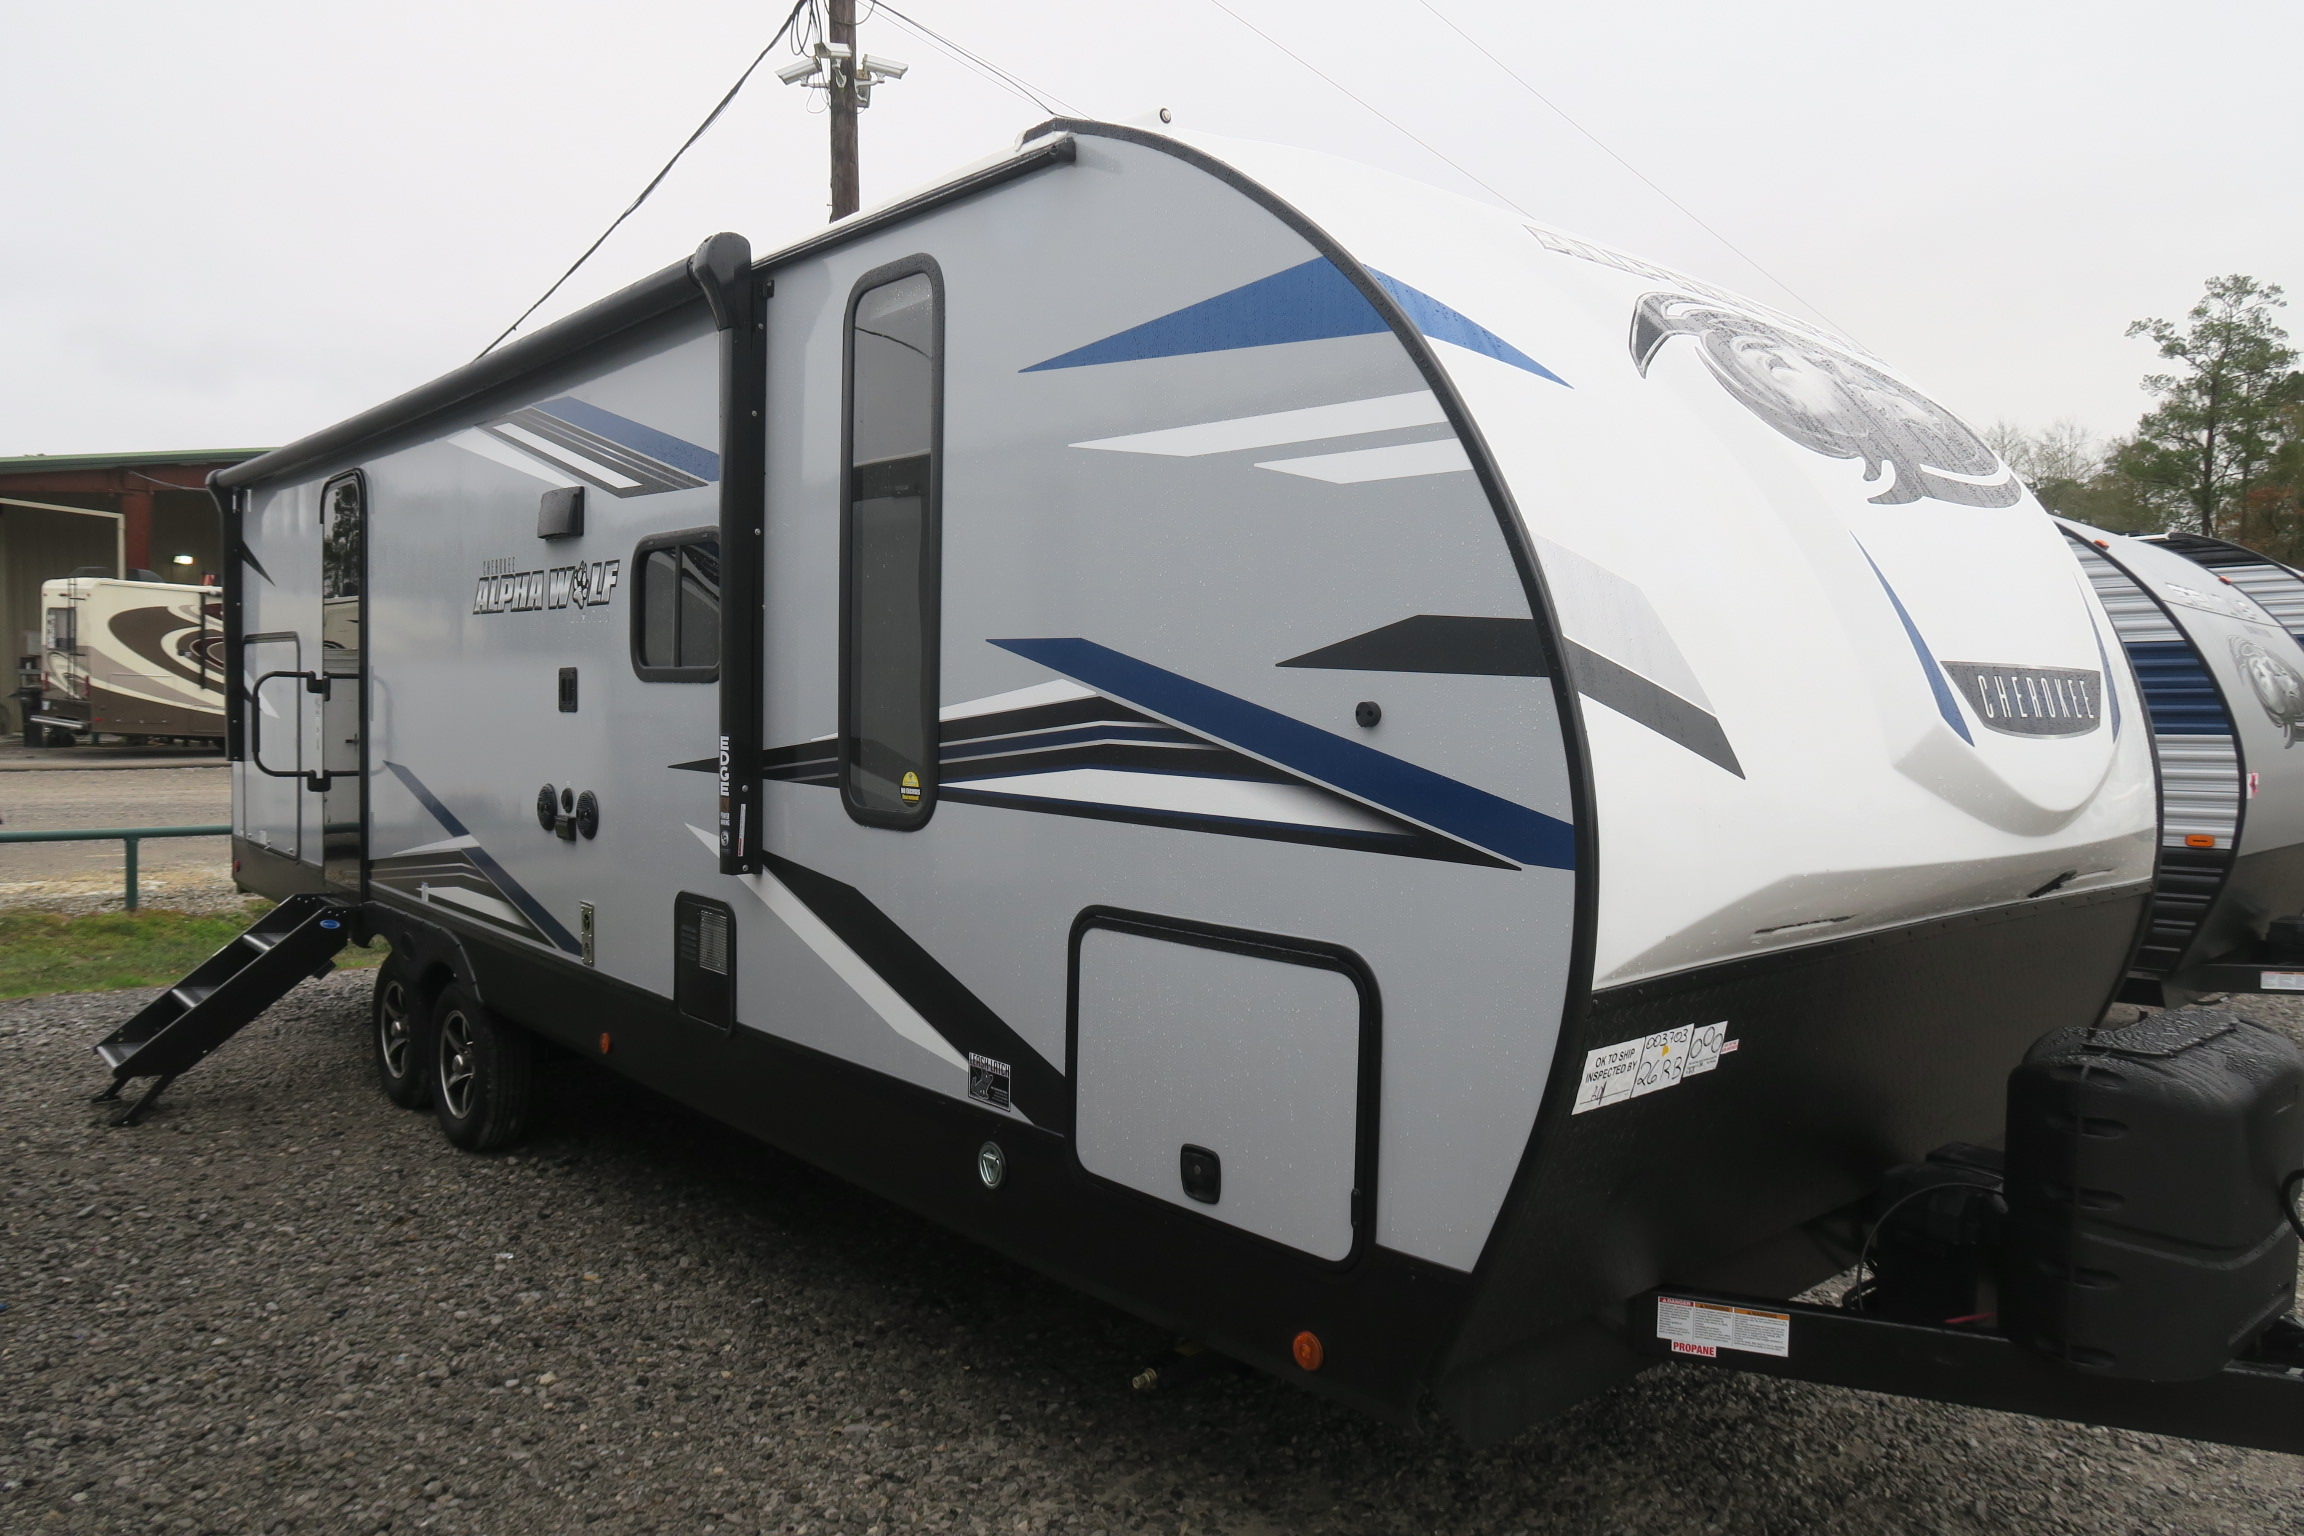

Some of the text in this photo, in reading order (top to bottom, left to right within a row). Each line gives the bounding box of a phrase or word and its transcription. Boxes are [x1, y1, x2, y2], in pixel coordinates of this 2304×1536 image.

[473, 570, 545, 615] ALPHA
[1977, 675, 2094, 719] CHEROKEE
[720, 735, 730, 796] EDGE
[1595, 1048, 1636, 1068] OK TO SHIP
[1585, 1060, 1638, 1084] INSPECTED BY
[1667, 1299, 1691, 1307] DANGER
[1673, 1341, 1715, 1357] PROPANE
